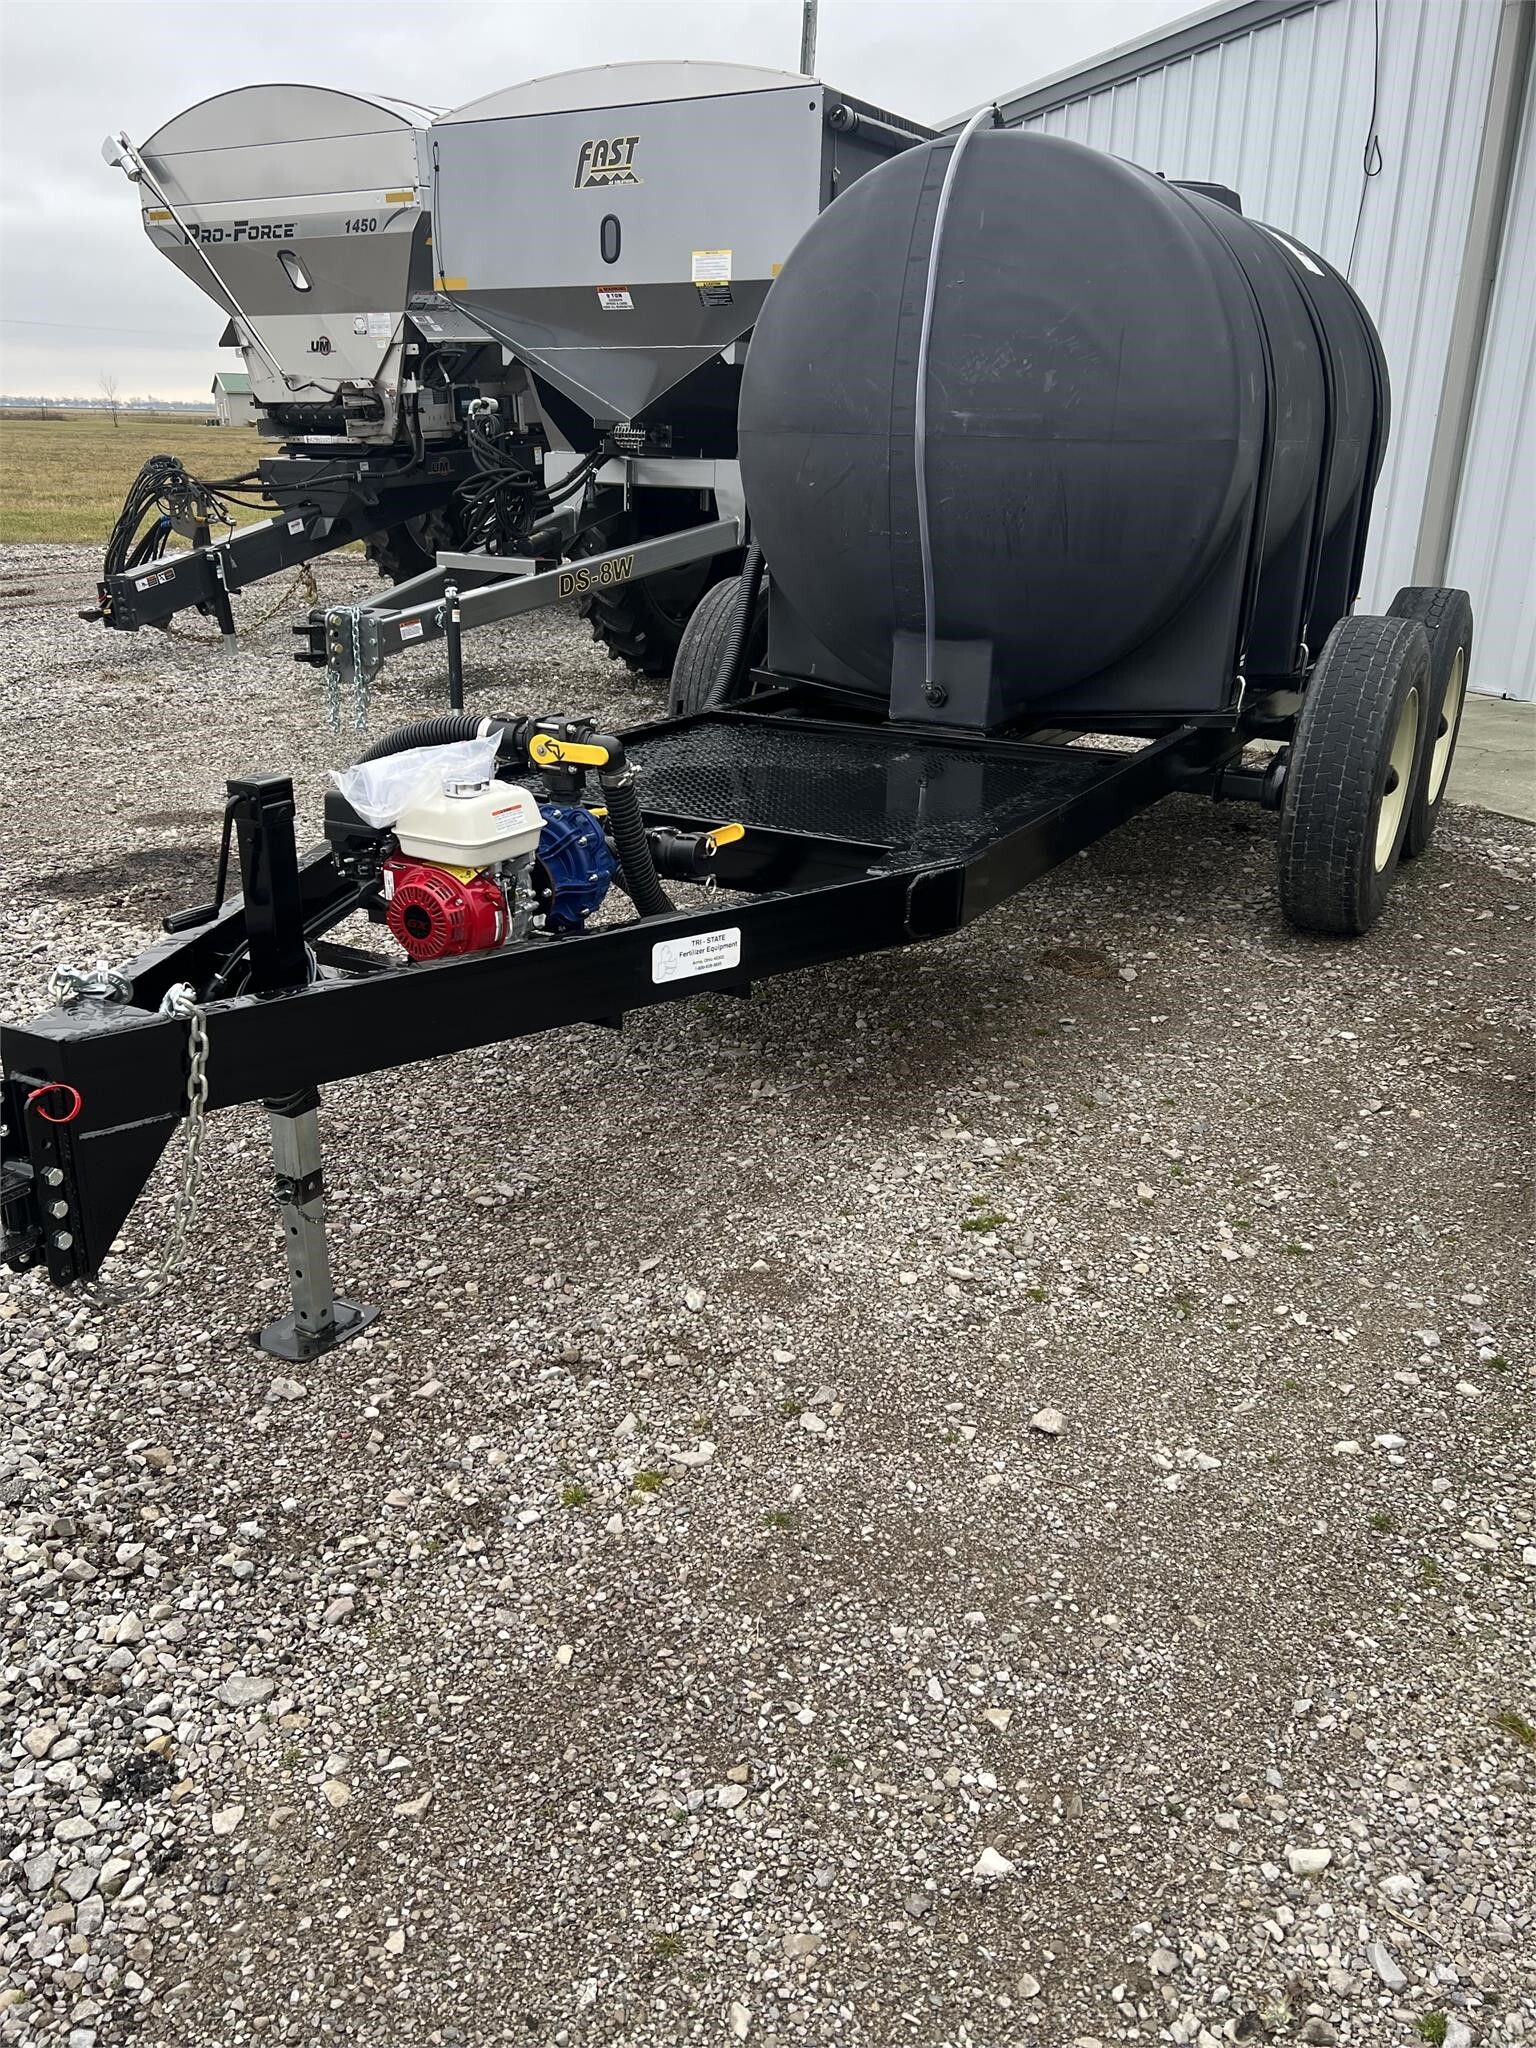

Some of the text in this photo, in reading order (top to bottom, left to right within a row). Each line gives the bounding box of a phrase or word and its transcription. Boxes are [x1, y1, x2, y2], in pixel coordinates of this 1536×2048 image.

[574, 136, 640, 188] FAST
[345, 217, 377, 233] 1450
[559, 554, 634, 598] DS-8W
[679, 941, 738, 957] Fertilizer Equipment
